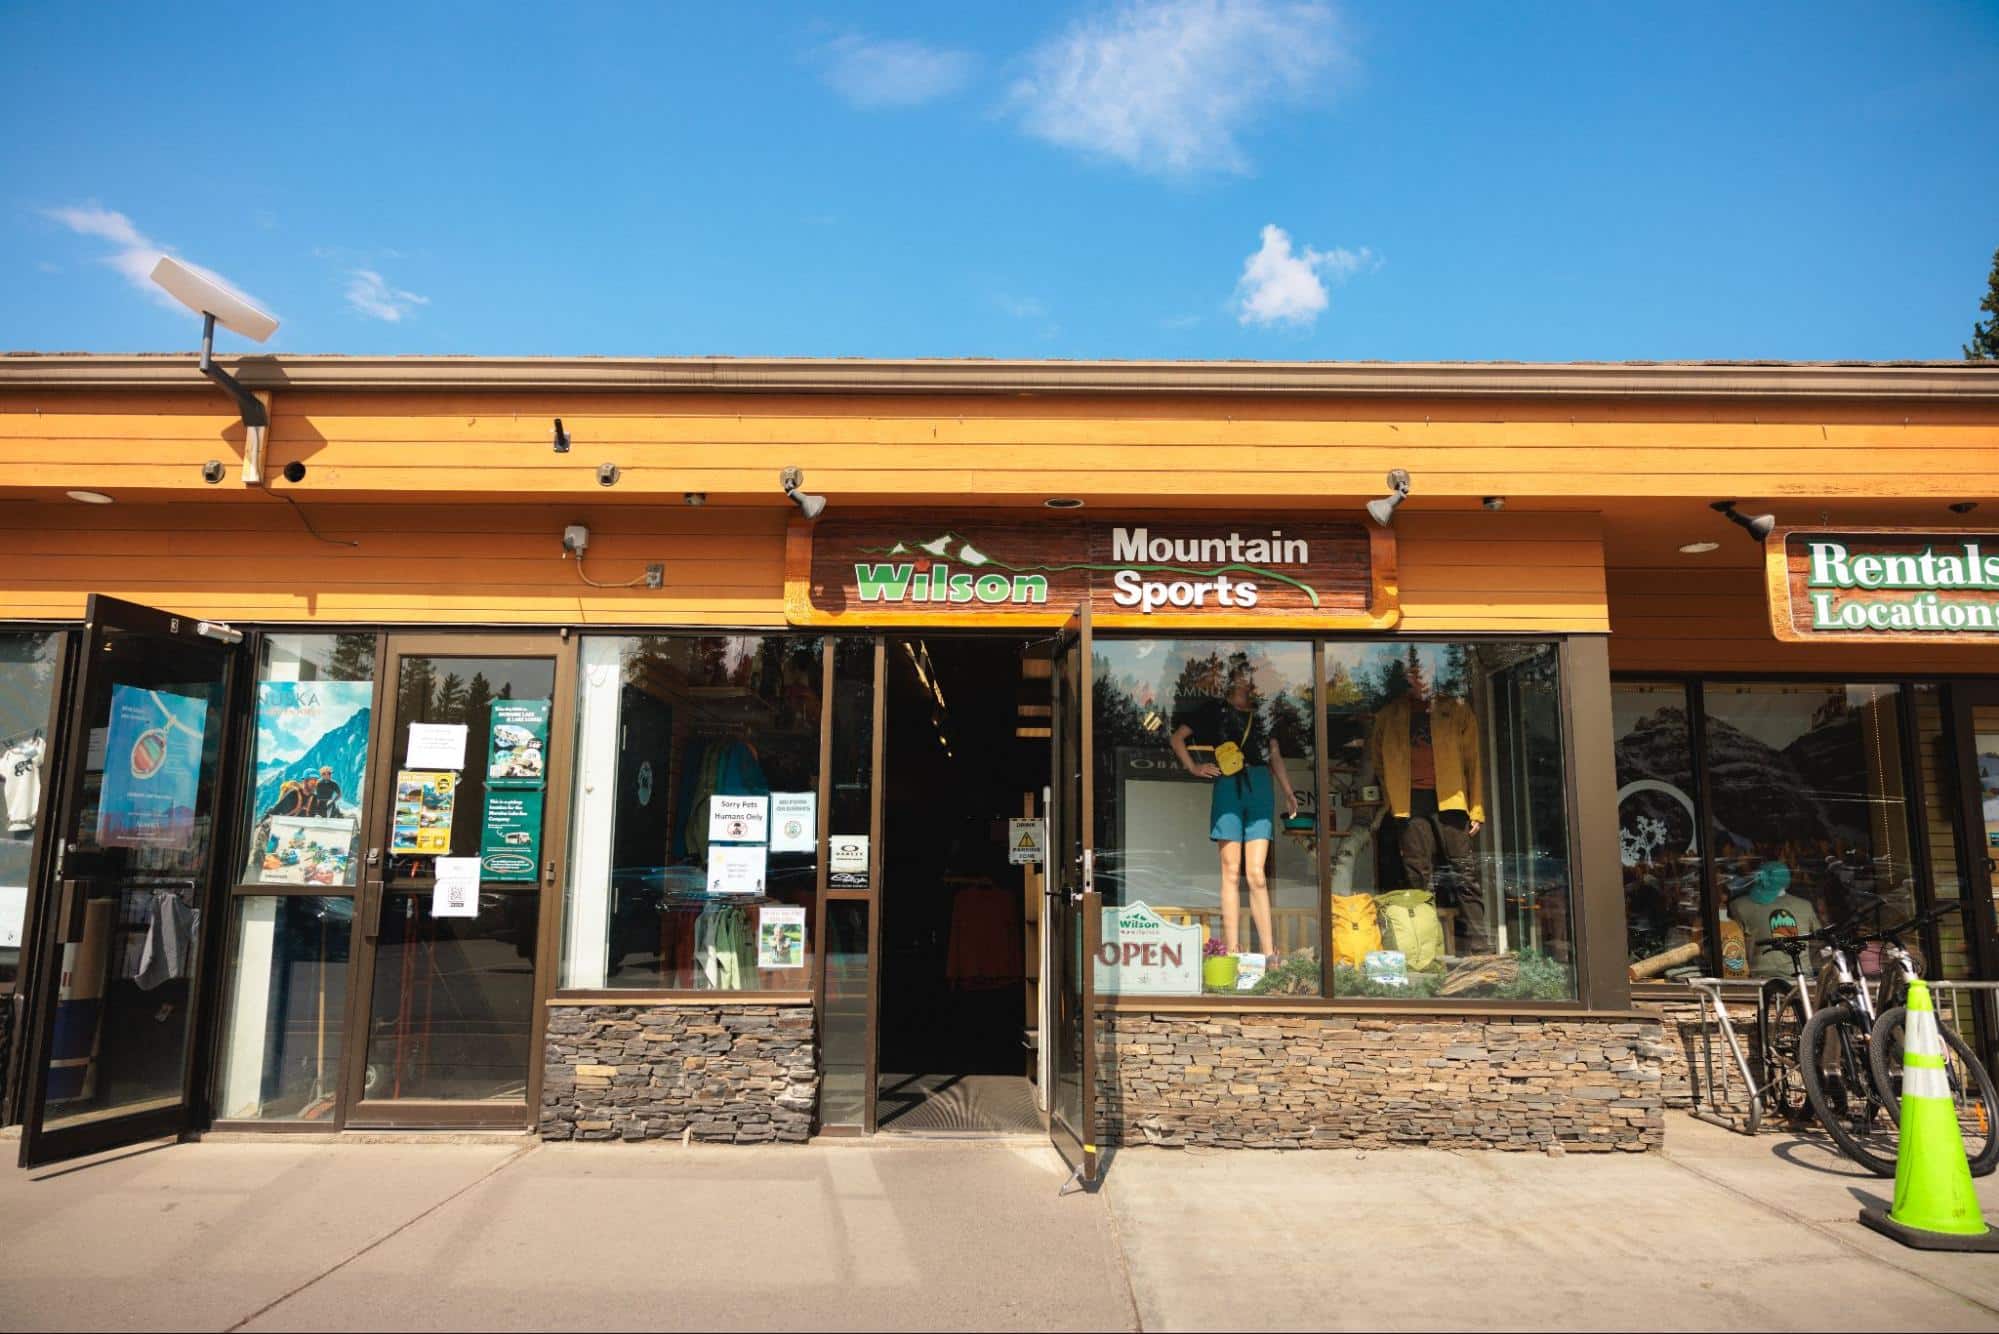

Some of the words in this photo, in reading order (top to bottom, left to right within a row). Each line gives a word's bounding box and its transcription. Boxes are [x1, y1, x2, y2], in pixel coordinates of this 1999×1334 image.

[1112, 528, 1309, 564] Mountain
[1809, 543, 1999, 587] Rentals
[854, 561, 1048, 604] Wilson
[1112, 571, 1259, 614] Sports
[1813, 594, 1999, 627] Location
[721, 800, 741, 809] Sorry
[746, 813, 763, 821] Only
[1120, 920, 1159, 929] Wilson
[1098, 942, 1183, 968] OPEN
